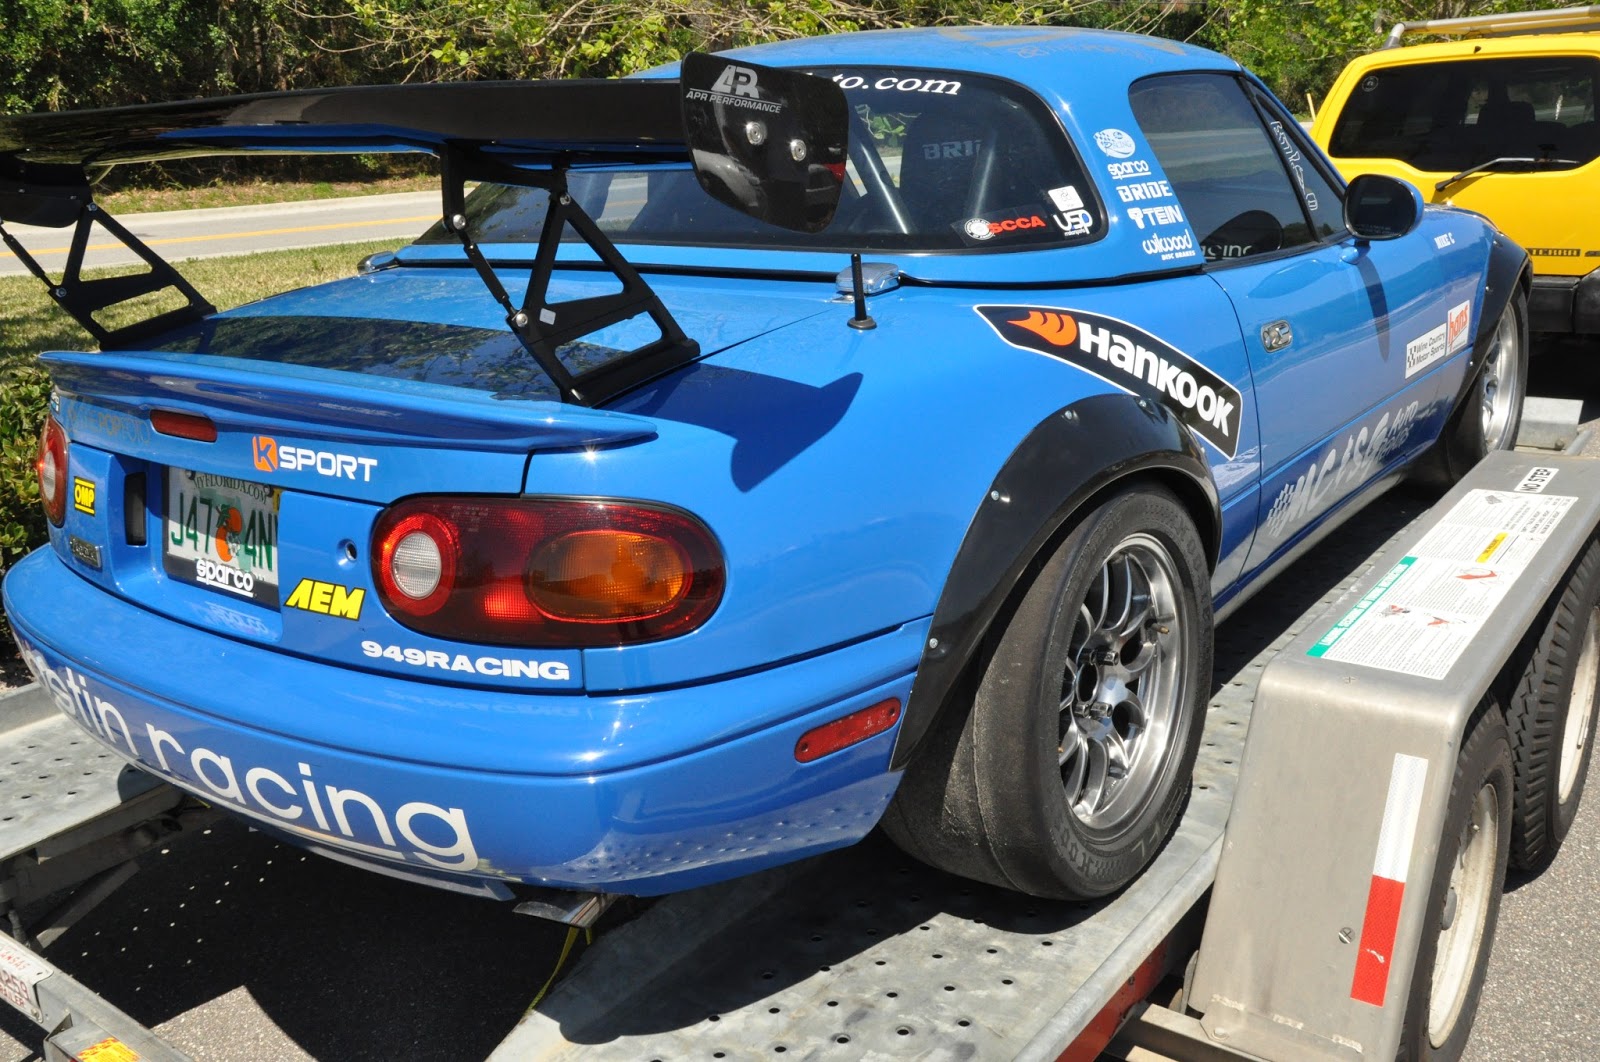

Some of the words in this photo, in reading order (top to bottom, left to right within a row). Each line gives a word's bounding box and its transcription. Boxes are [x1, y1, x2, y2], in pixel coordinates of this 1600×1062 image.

[832, 73, 962, 95] to.com
[686, 91, 707, 101] APR
[709, 94, 781, 113] PERFORMANCE
[922, 140, 982, 160] BRI
[1107, 160, 1150, 178] sparco
[1116, 180, 1173, 202] BRIDE
[987, 215, 1046, 234] SCCA
[1142, 205, 1184, 226] TEIN
[1161, 252, 1175, 261] DISC
[1528, 468, 1552, 483] STEP
[75, 484, 94, 508] OMP
[1519, 483, 1541, 493] NO
[171, 492, 213, 554] J47
[244, 509, 279, 572] 4N
[196, 558, 254, 595] sparco
[284, 580, 364, 618] AEM
[361, 640, 570, 681] 949RACING
[146, 722, 478, 872] racing
